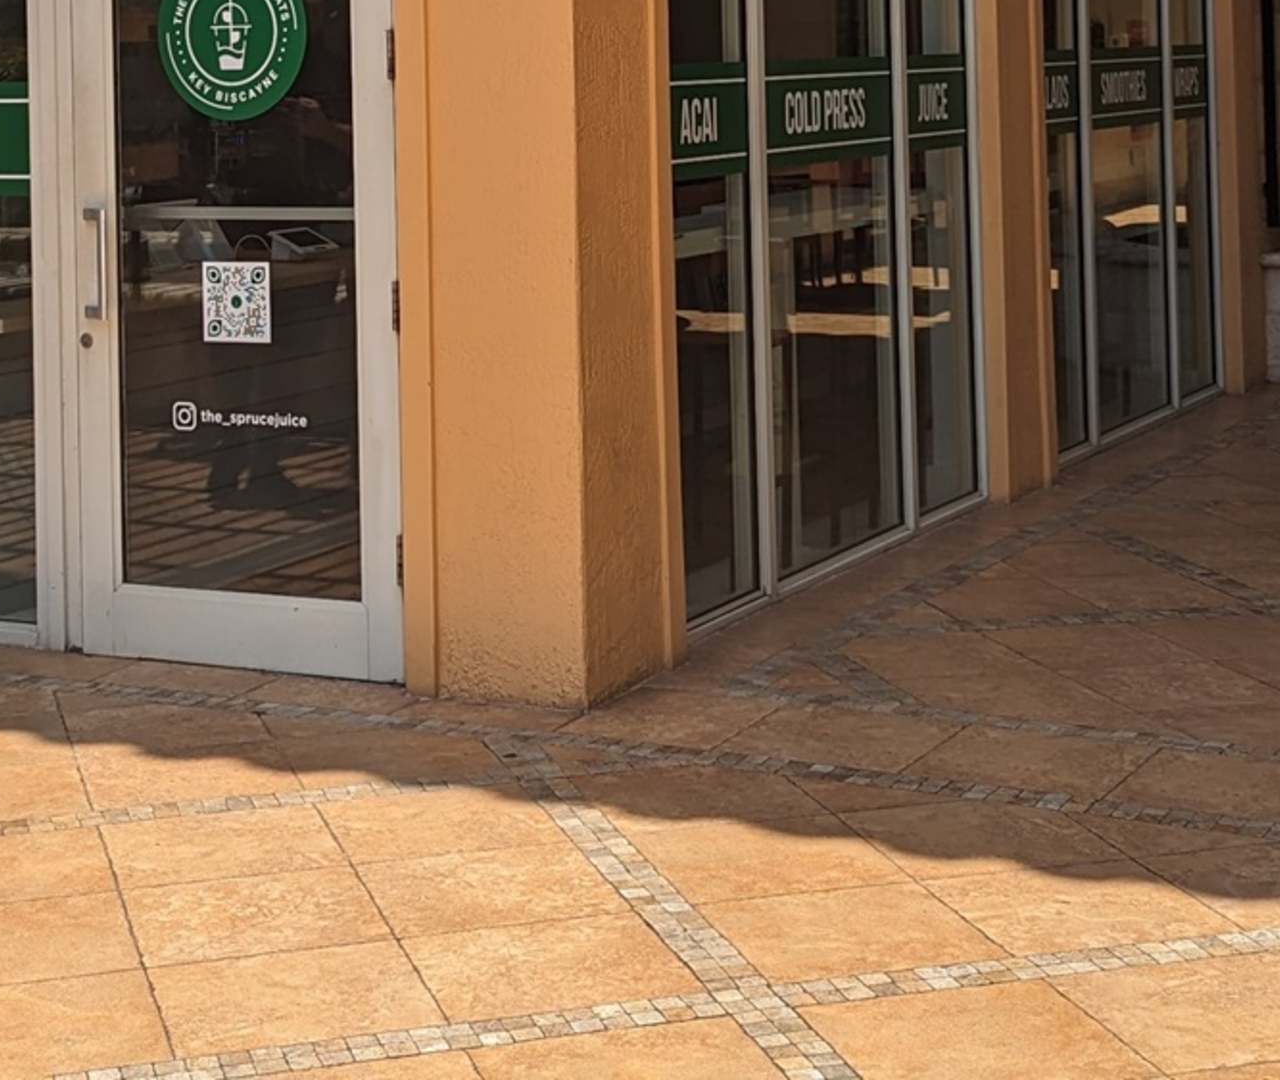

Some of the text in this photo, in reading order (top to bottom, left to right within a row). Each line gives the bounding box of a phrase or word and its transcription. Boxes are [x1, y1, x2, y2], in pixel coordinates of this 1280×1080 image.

[188, 69, 279, 104] KEY BISCAYNE
[917, 82, 950, 122] JUICE
[1046, 75, 1070, 110] LADS
[1100, 70, 1147, 104] SMOOTHIES
[679, 97, 719, 145] ACAI
[785, 87, 867, 135] COLD PRESS
[200, 409, 309, 429] the_sprucejuice
